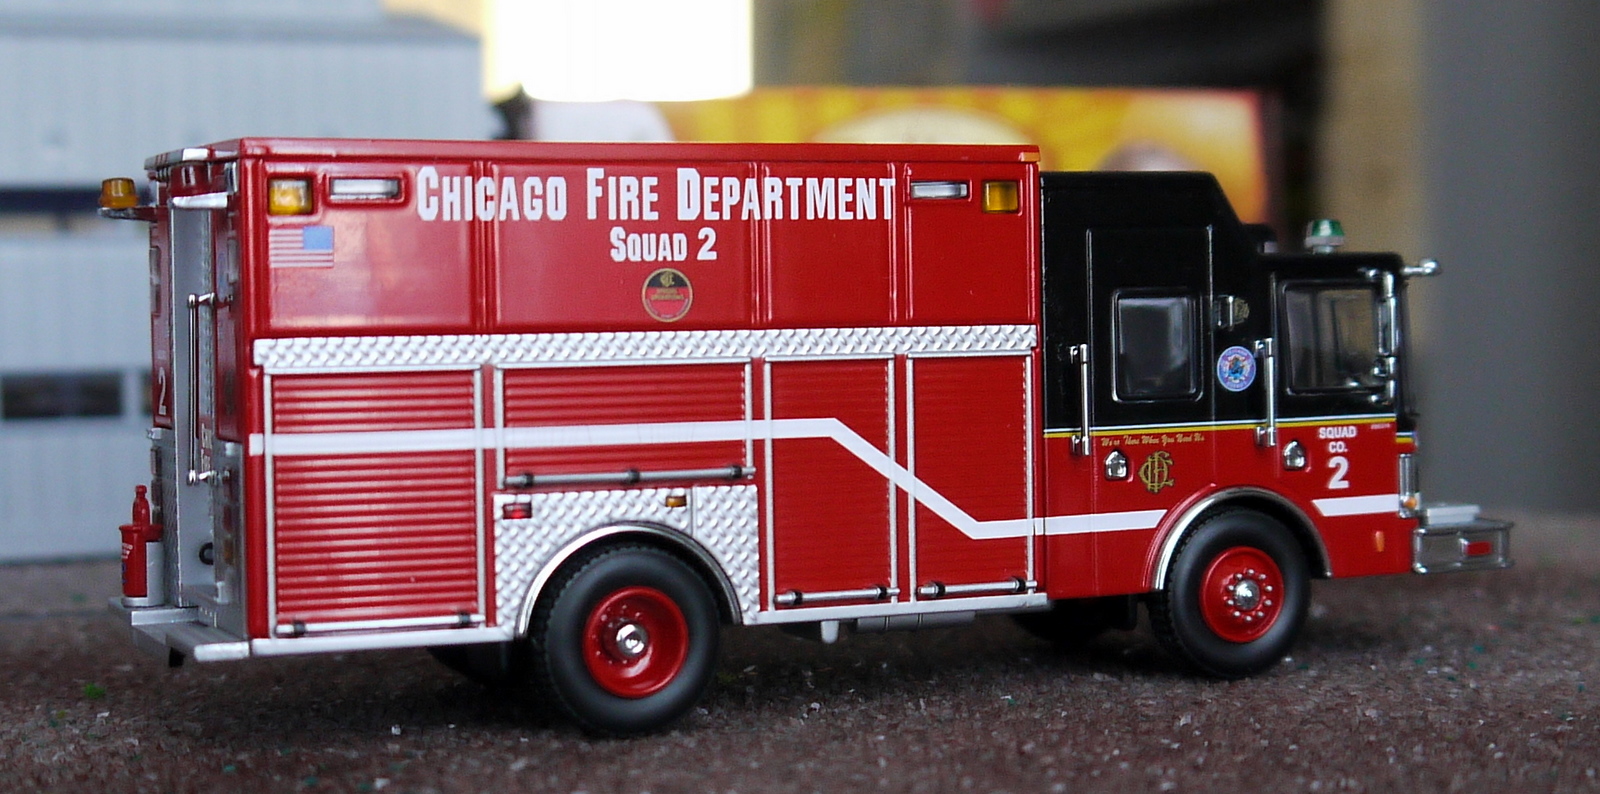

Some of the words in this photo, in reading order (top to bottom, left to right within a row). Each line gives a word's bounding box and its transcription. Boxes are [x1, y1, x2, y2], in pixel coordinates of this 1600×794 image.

[610, 227, 687, 262] SQUAD
[697, 228, 717, 261] 2
[158, 366, 167, 415] 2
[1161, 435, 1175, 447] You
[1318, 426, 1357, 439] SQUAD
[1328, 441, 1348, 453] CO.
[1328, 455, 1350, 489] 2
